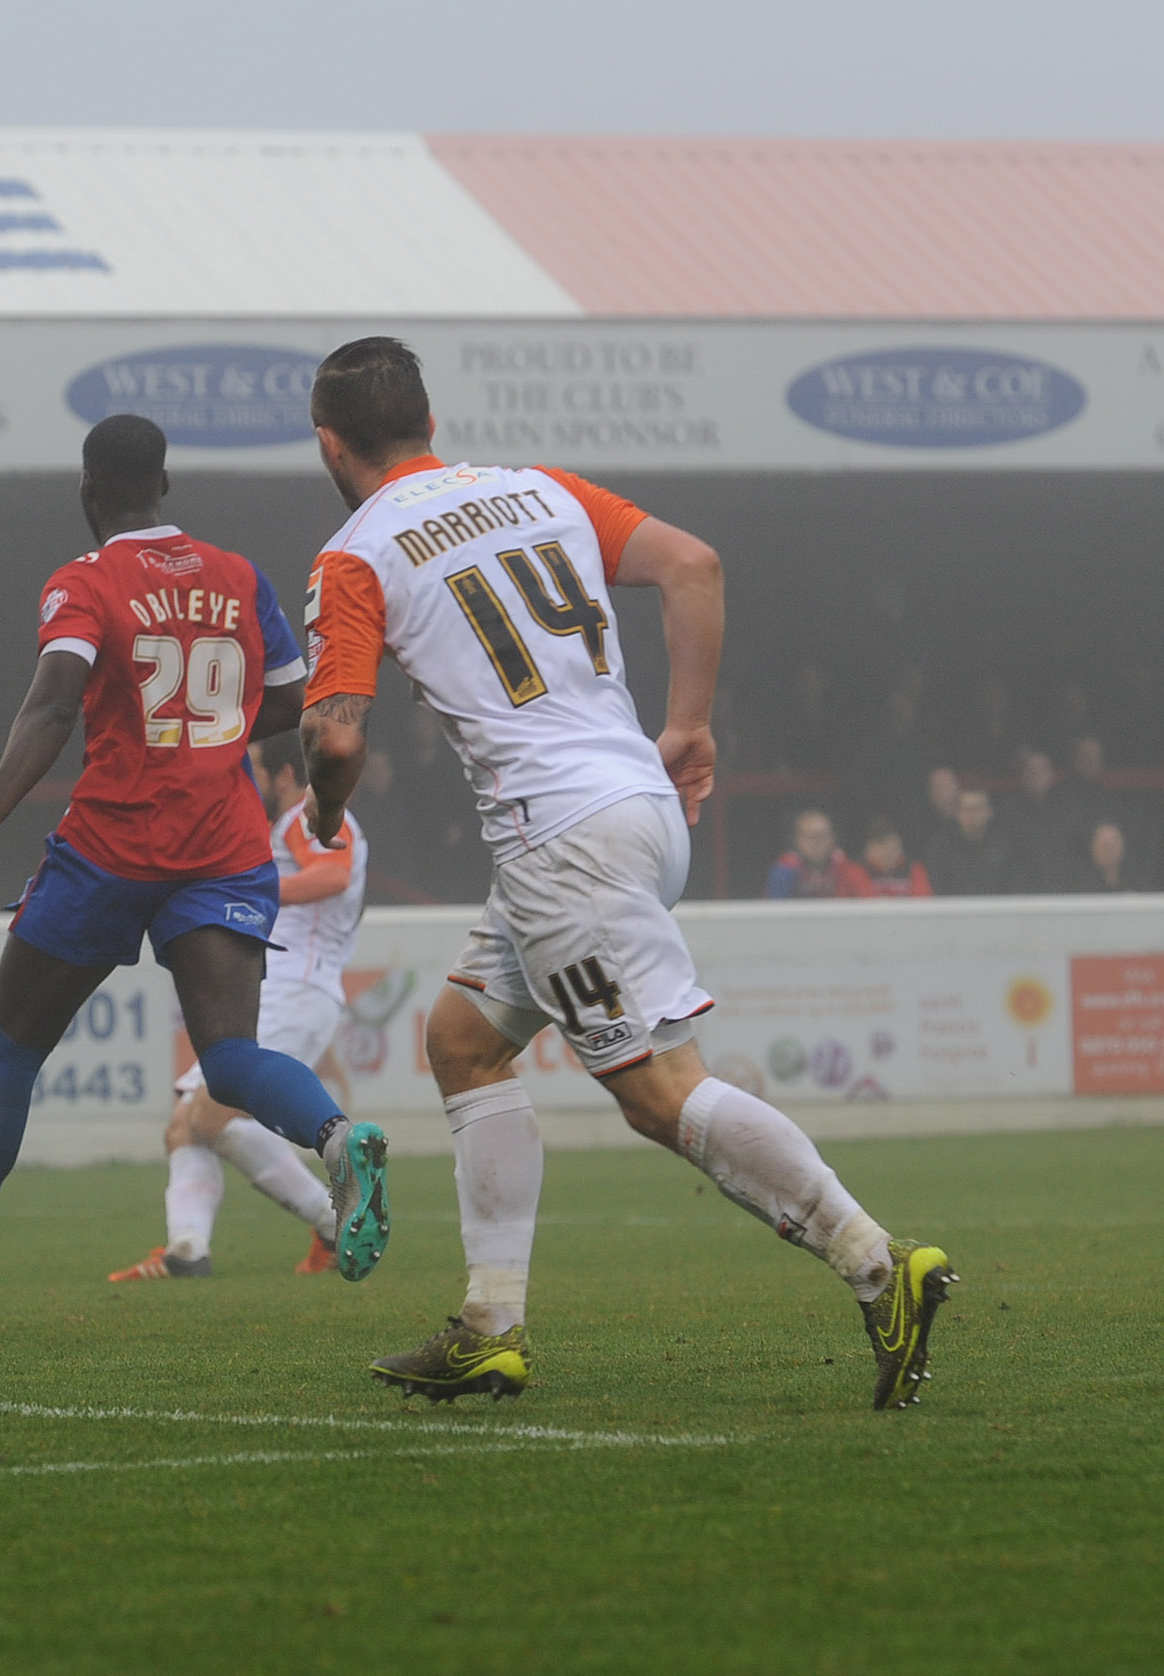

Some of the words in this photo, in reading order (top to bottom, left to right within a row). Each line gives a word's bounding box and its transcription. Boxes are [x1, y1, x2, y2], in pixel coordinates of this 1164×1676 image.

[459, 341, 594, 374] PROUD
[598, 341, 652, 374] TO
[657, 341, 699, 374] BE
[103, 362, 212, 398] WEST
[220, 362, 260, 399] &
[263, 362, 317, 398] CO
[485, 379, 549, 412] THE
[821, 365, 924, 400] WEST
[931, 365, 969, 400] &
[973, 365, 1048, 400] COE
[444, 417, 544, 447] MAIN
[551, 417, 722, 447] SPONSOR
[393, 468, 494, 503] ELECSA
[392, 489, 556, 568] MARRIOTT
[129, 588, 241, 630] OBILEYE
[445, 541, 610, 708] 14
[132, 634, 246, 748] 29
[547, 955, 626, 1035] 14
[589, 1023, 629, 1049] FILA
